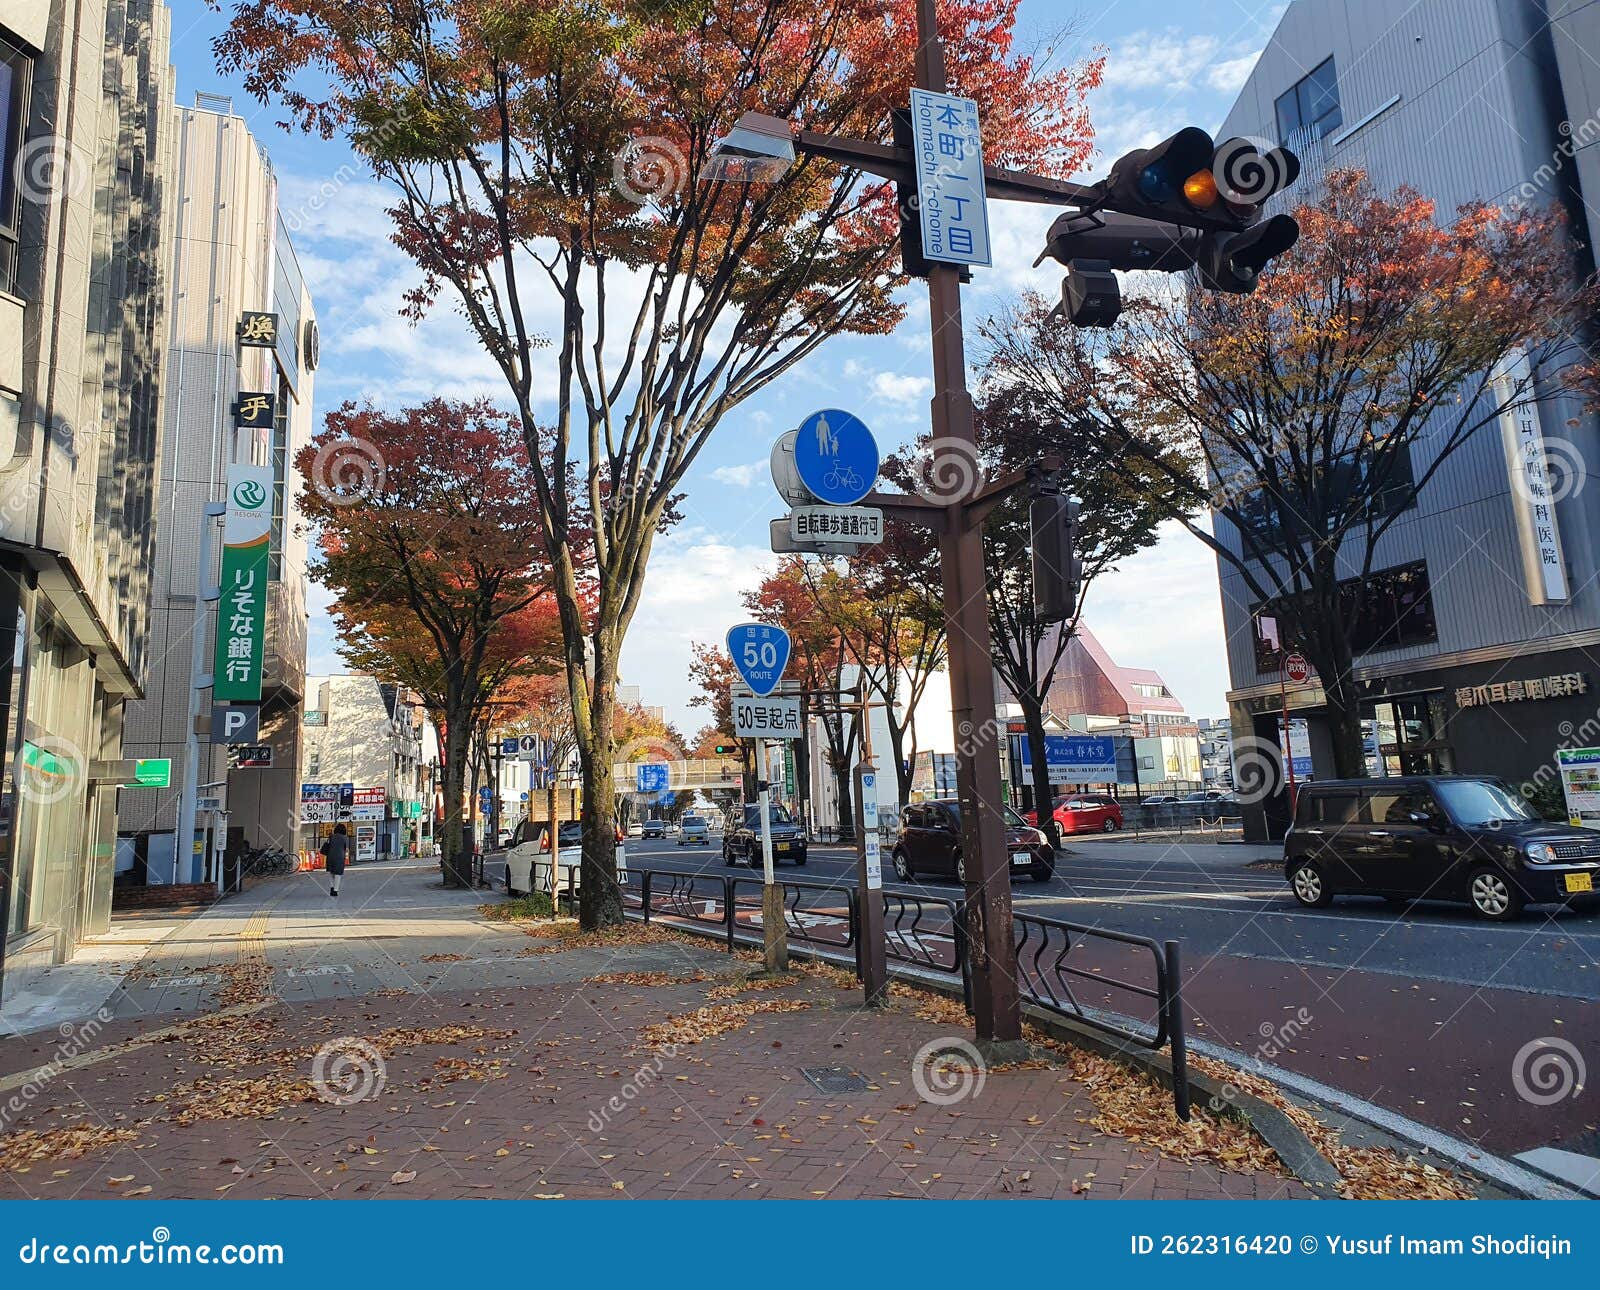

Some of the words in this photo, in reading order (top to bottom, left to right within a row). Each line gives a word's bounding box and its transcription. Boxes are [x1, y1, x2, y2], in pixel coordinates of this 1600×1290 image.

[919, 96, 939, 176] Honmachi
[936, 103, 973, 254] 本町一丁目
[927, 185, 943, 253] 1-chome
[234, 511, 263, 519] RESONA
[797, 515, 879, 535] 自転車歩道通行可
[226, 569, 256, 682] りそな銀行
[746, 627, 771, 638] 国道
[743, 642, 777, 668] 50
[750, 671, 772, 680] ROUTE
[1455, 672, 1587, 708] 橋爪耳鼻咽喉科
[224, 711, 247, 737] P
[738, 705, 798, 730] 50号起点
[343, 789, 351, 797] P
